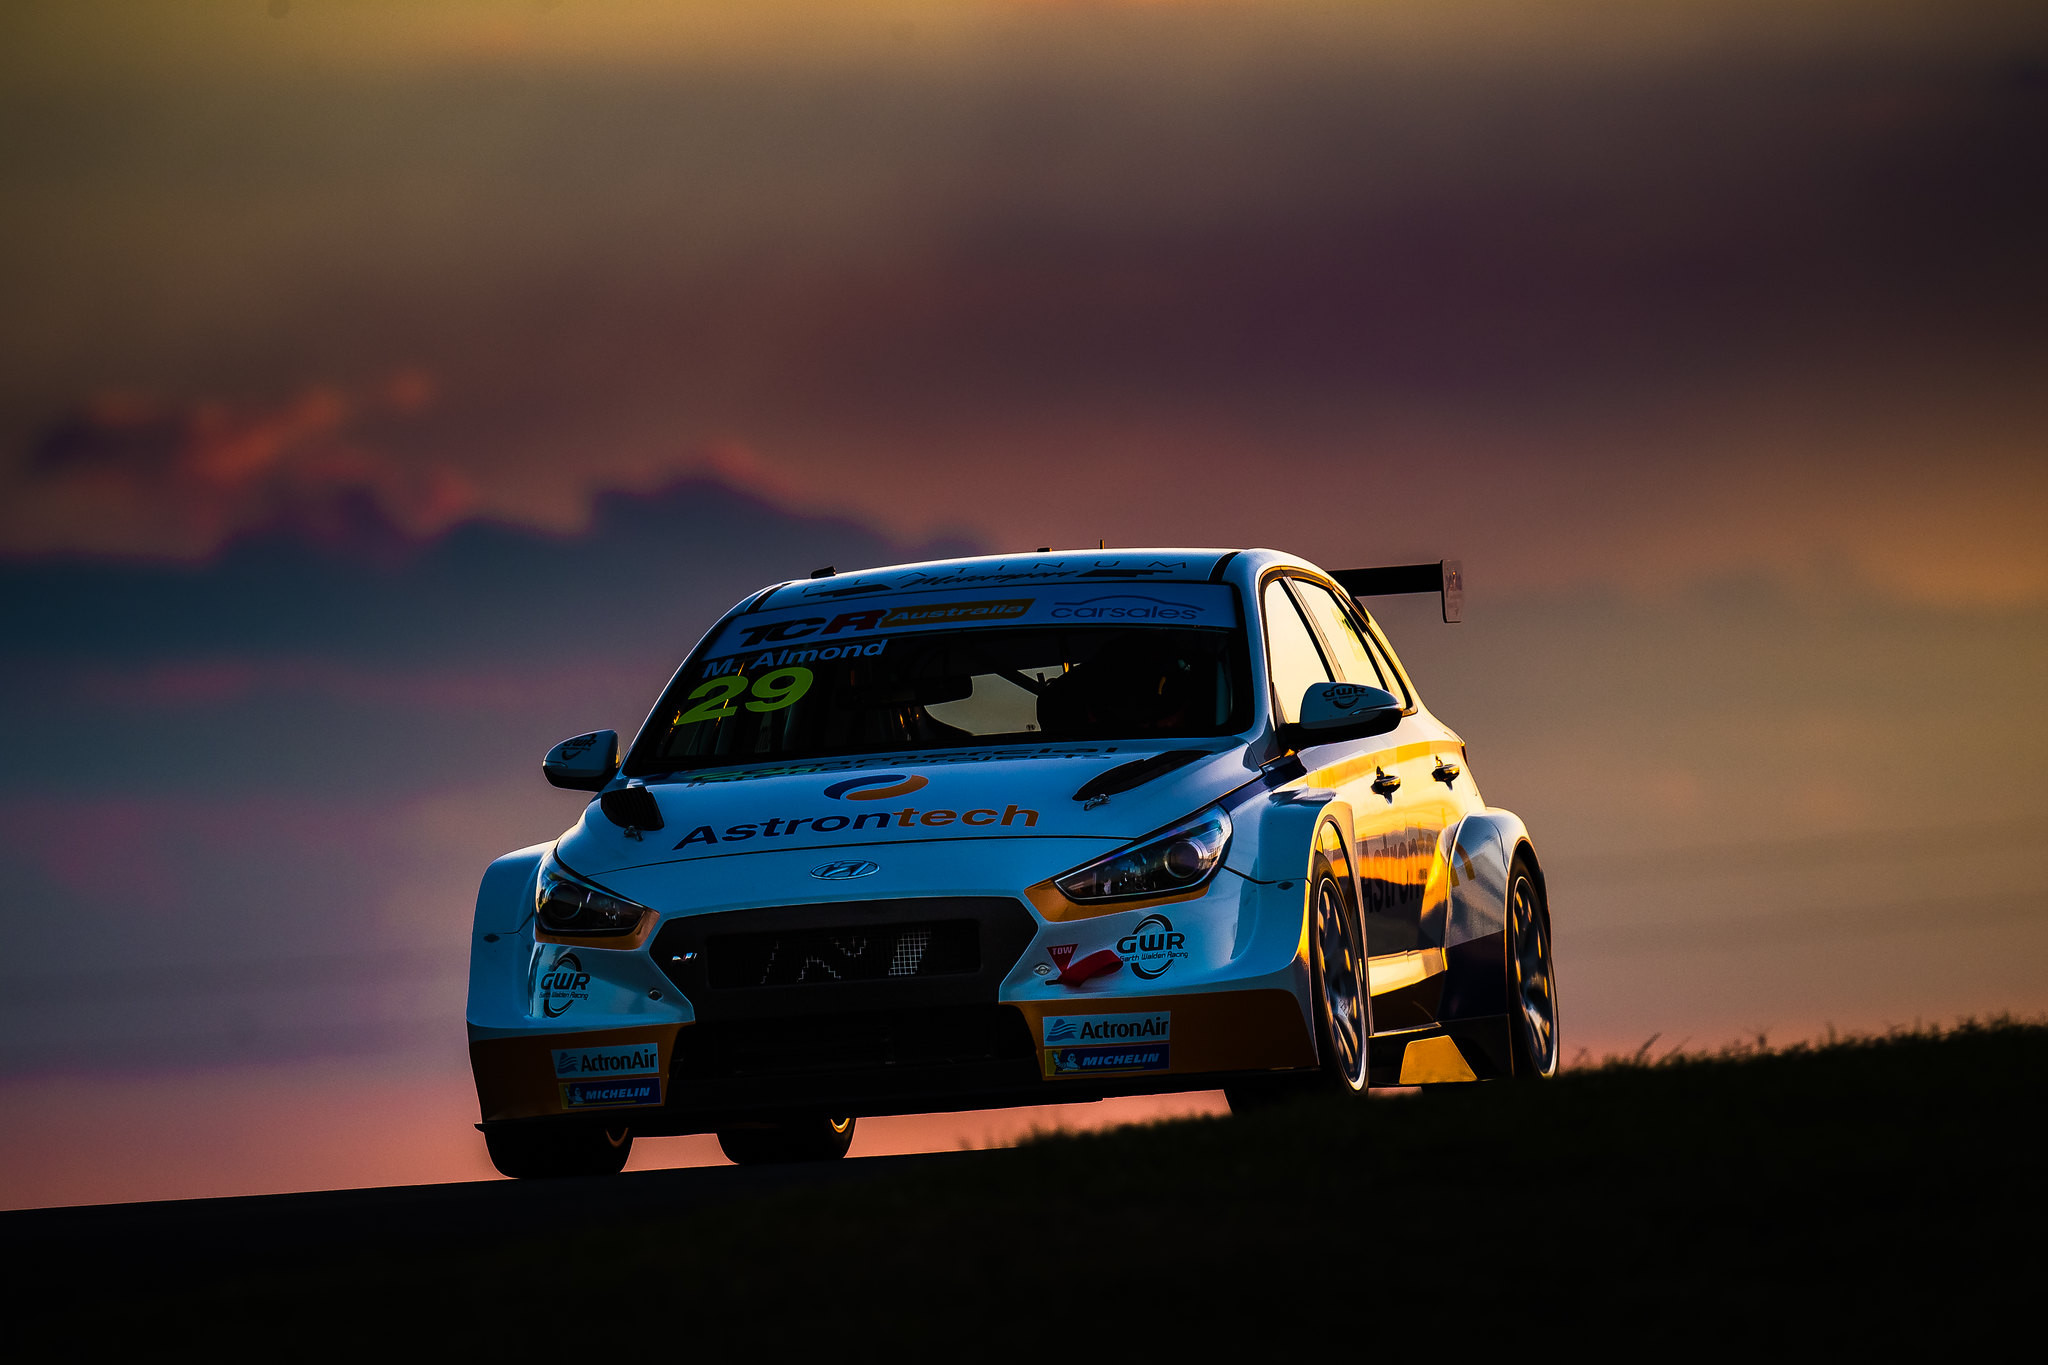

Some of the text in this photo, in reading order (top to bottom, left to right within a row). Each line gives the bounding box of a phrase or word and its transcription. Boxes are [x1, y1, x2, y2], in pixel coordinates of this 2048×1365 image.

[895, 602, 1024, 624] Australia
[1050, 604, 1198, 620] carsales
[739, 609, 887, 648] TCR
[702, 639, 889, 680] M. Almond
[674, 666, 814, 727] 29
[1322, 686, 1366, 698] GWR
[671, 804, 1040, 851] Astrontech
[1052, 946, 1073, 956] TOW
[1116, 932, 1186, 953] GWR
[1167, 950, 1189, 959] Racing
[540, 972, 591, 990] GWR
[1080, 1017, 1168, 1040] ActronAir
[581, 1049, 656, 1073] ActronAir
[1082, 1052, 1160, 1068] MICHELIN
[585, 1086, 651, 1101] MICHELIN
